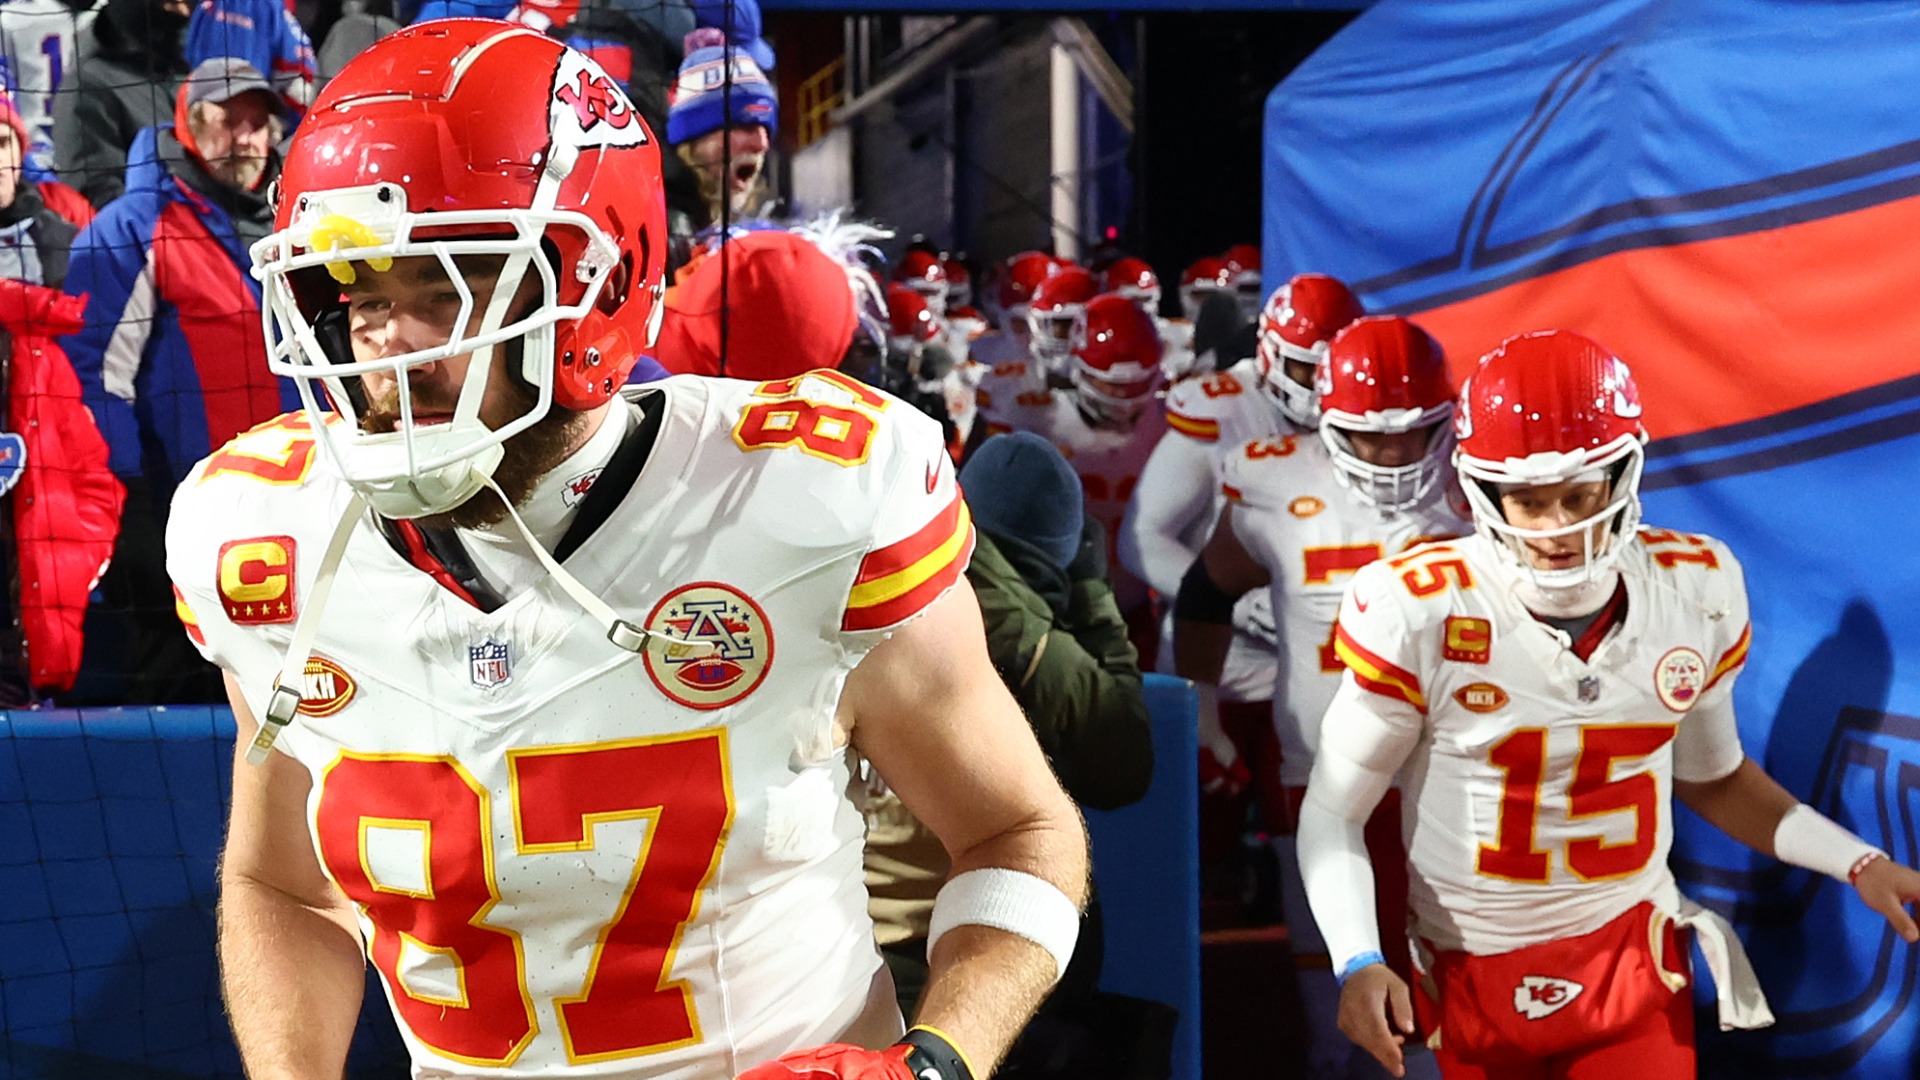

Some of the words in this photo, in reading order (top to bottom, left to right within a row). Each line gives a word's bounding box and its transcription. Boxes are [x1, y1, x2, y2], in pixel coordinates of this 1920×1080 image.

[731, 368, 892, 468] 87
[220, 541, 289, 602] C
[475, 660, 507, 682] NFL
[664, 602, 754, 663] A
[1475, 723, 1680, 886] 15
[316, 726, 736, 1067] 87
